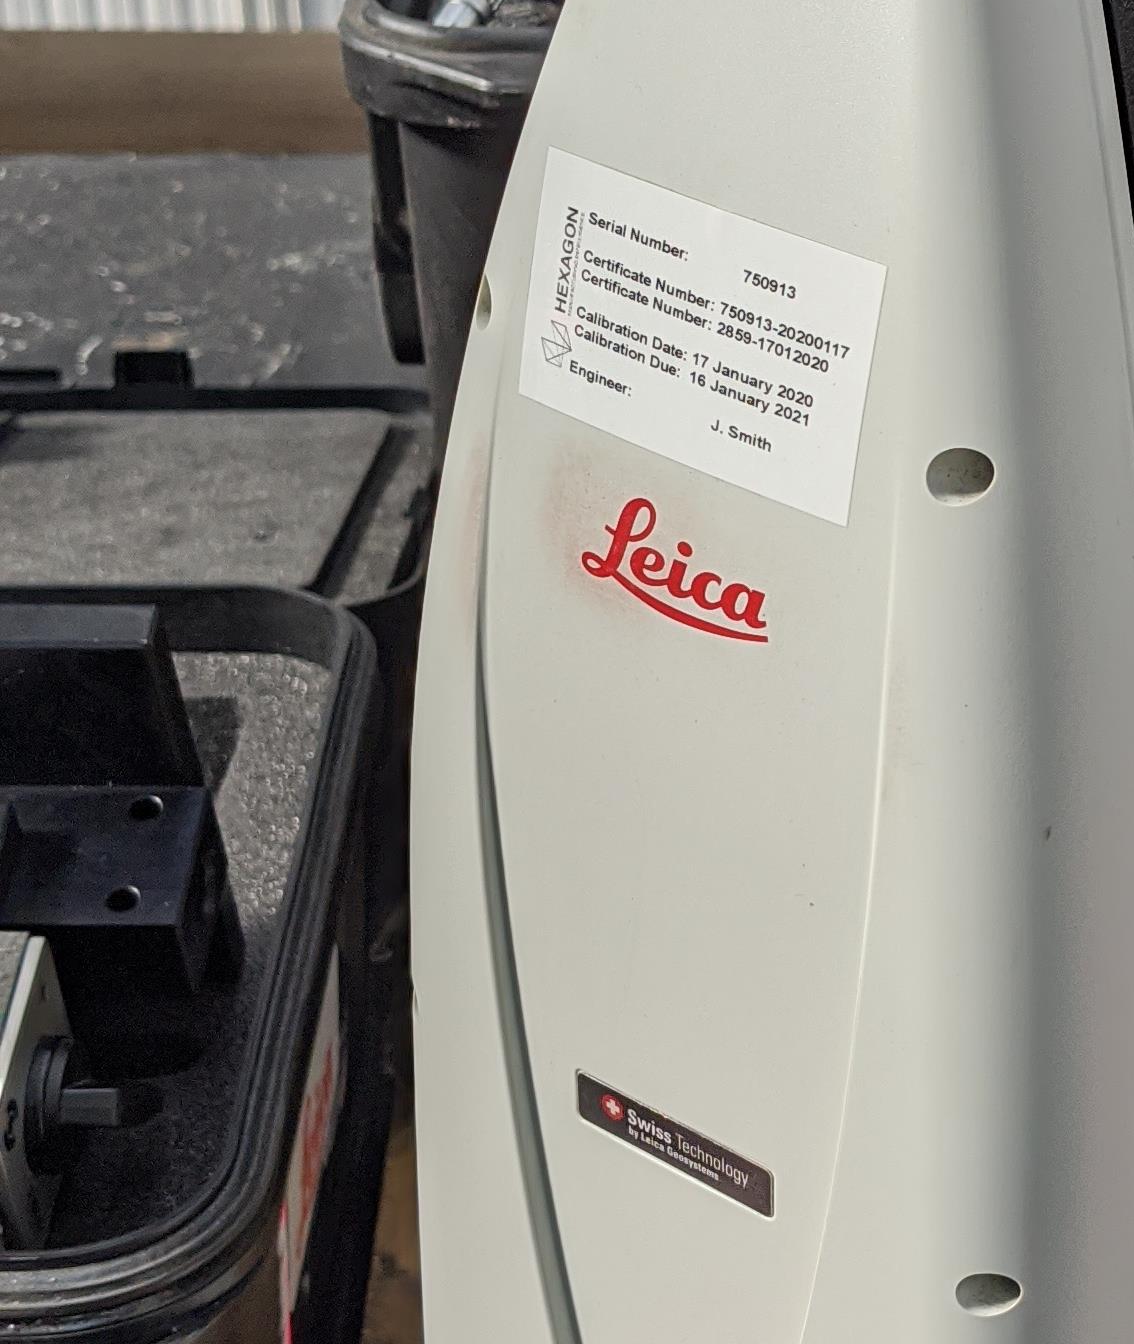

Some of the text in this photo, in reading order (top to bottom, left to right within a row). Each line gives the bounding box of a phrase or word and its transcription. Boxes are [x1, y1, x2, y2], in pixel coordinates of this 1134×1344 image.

[555, 206, 579, 313] HEXAGON
[587, 212, 689, 261] Serial Number:
[742, 269, 797, 300] 750913
[581, 269, 830, 373] Certificate Number: 2859-17012020
[583, 250, 851, 360] Certificate Number: 750913-20200117
[569, 360, 632, 397] Engineer:
[574, 324, 811, 427] Calibration Due: 16 January 2021
[576, 306, 814, 408] Calibration Date: 17 January 2020
[710, 419, 773, 452] J. Smith
[581, 497, 769, 643] Leica
[627, 1108, 749, 1188] Swiss Technology
